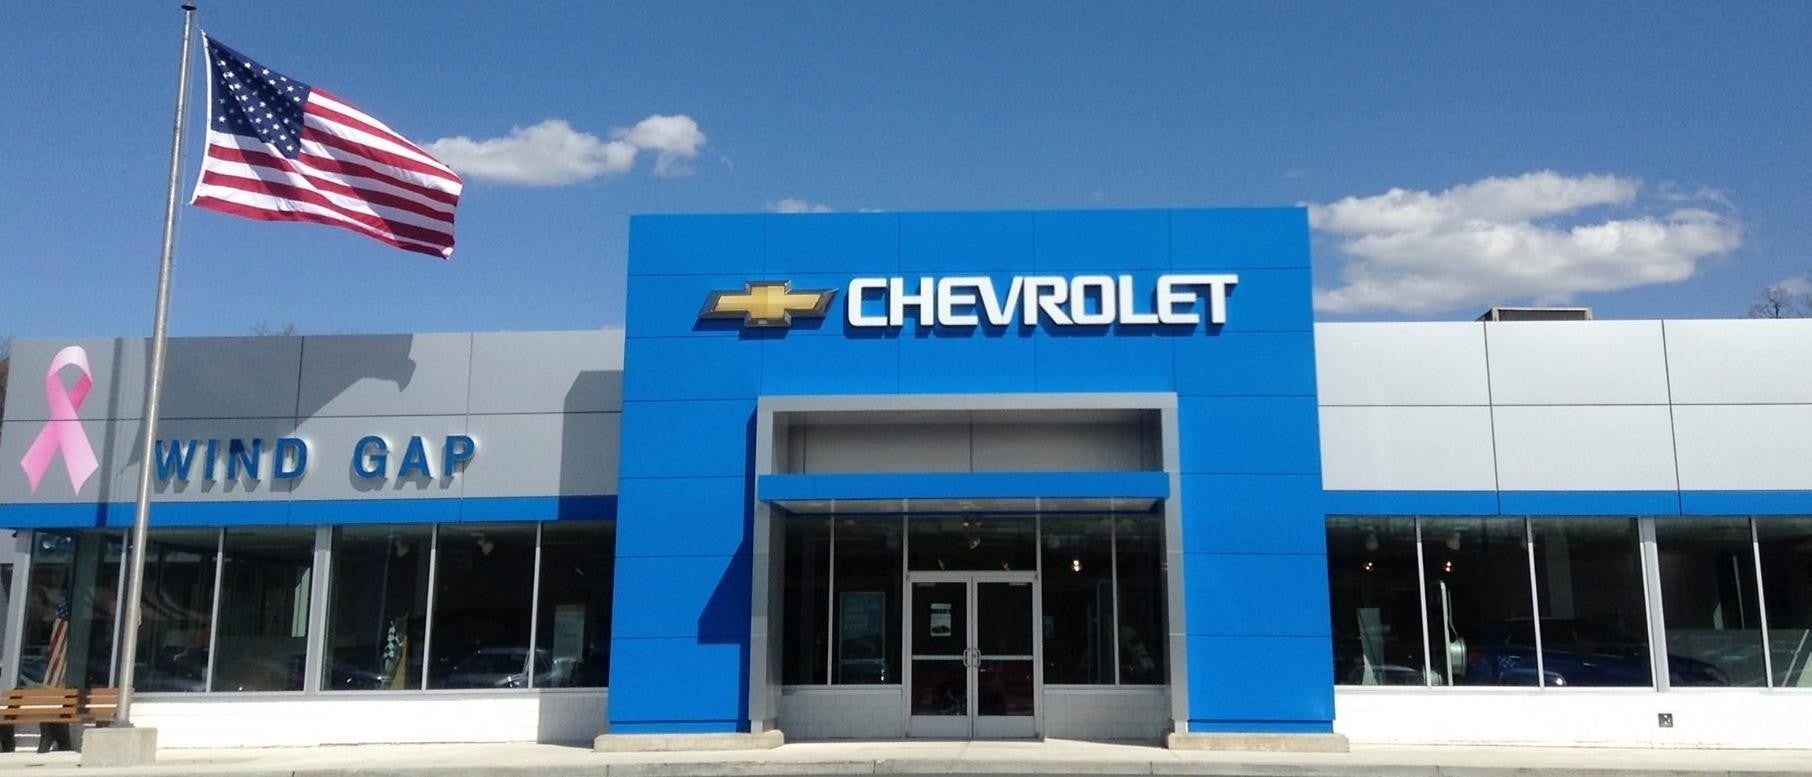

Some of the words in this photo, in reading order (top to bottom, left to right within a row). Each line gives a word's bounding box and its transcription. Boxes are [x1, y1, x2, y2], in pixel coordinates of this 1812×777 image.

[848, 274, 1238, 327] CHEVROLET
[155, 437, 308, 481] WIND
[353, 435, 476, 479] GAP
